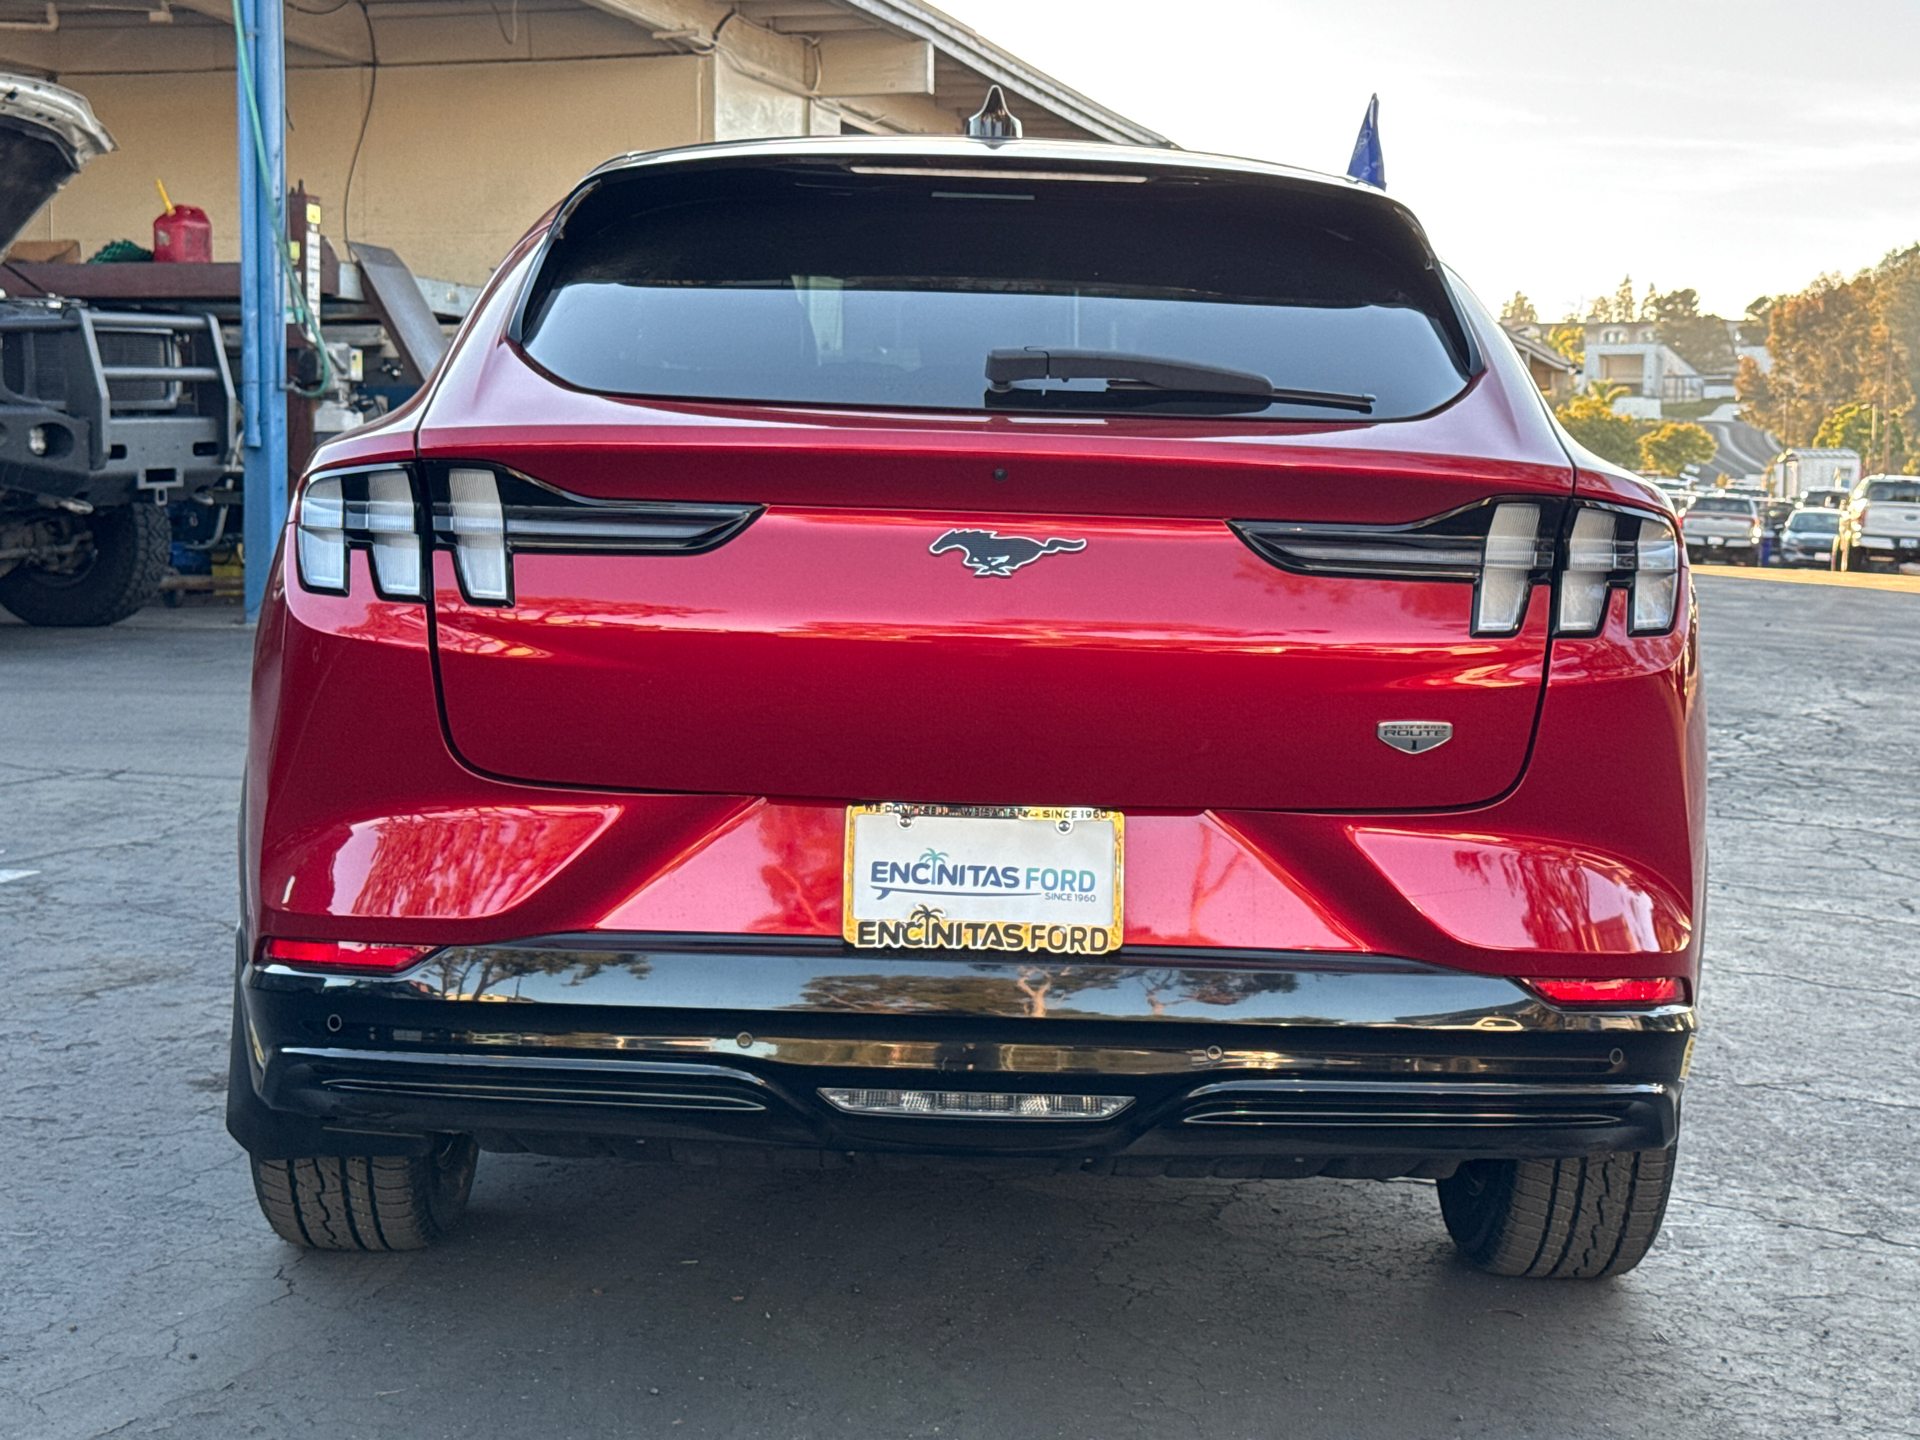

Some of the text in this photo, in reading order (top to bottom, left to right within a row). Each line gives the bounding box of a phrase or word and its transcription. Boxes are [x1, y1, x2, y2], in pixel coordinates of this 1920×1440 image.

[1042, 809, 1078, 819] SINCE
[1080, 810, 1108, 819] 1960
[871, 854, 1096, 892] ENCINITAS FORD
[1044, 892, 1097, 903] SINCE 1960
[857, 912, 1109, 952] ENCINITAS FORD
